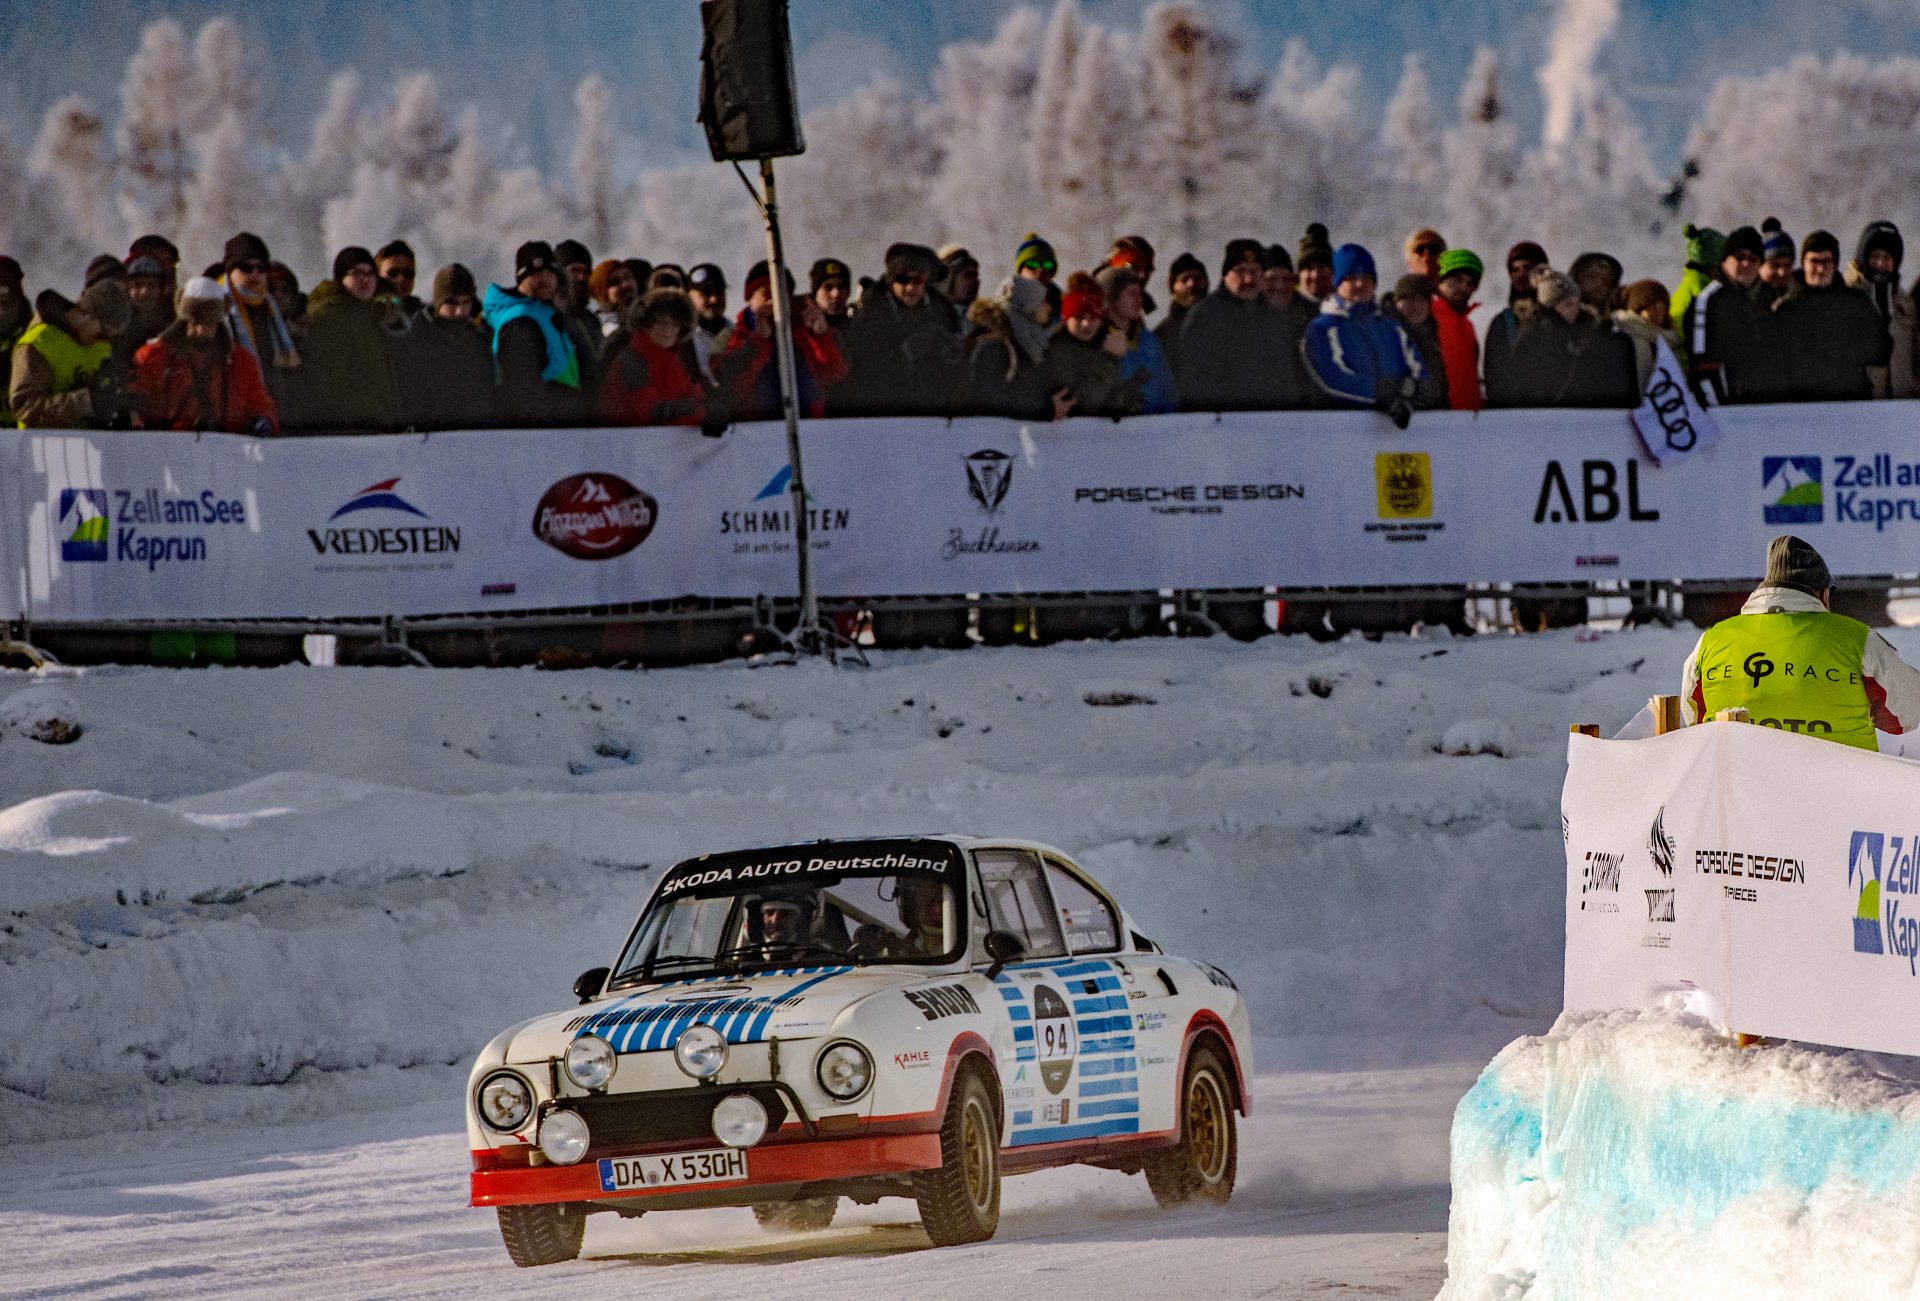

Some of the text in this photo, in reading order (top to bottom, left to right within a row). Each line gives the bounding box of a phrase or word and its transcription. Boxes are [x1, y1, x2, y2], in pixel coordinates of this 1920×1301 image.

[1075, 483, 1305, 503] PORSCHE DESIGN
[1534, 459, 1660, 523] ABL
[720, 508, 850, 534] SCHMITEN
[1836, 491, 1920, 533] Kapru
[117, 526, 207, 573] Kaprun
[306, 527, 461, 555] VREDESTEIN
[1784, 662, 1858, 685] RACE
[737, 860, 803, 880] AUTO
[806, 854, 948, 873] Deutschland
[1747, 854, 1805, 884] DESIGN
[1045, 1023, 1068, 1057] 94
[894, 1051, 930, 1069] KAHLE
[613, 1161, 646, 1186] DA
[661, 1157, 677, 1182] X
[681, 1151, 744, 1180] 530H
